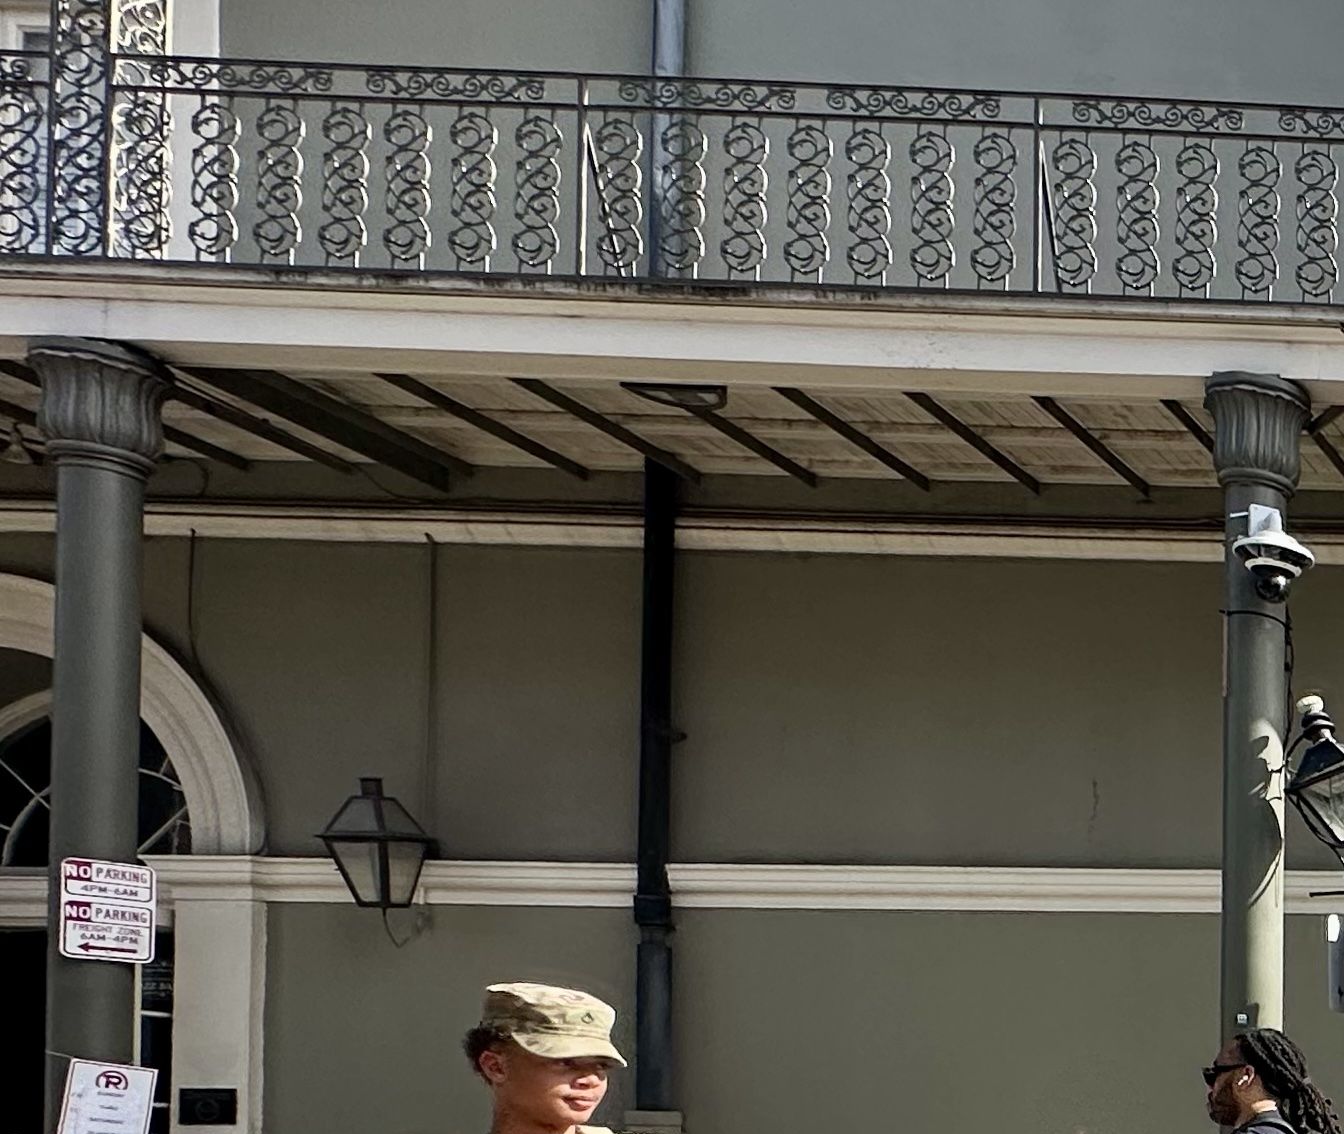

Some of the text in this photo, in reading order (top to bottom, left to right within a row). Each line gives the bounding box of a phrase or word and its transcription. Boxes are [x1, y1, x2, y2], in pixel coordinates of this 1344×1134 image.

[65, 864, 148, 884] NO PARKING
[65, 905, 148, 923] NO PARKING
